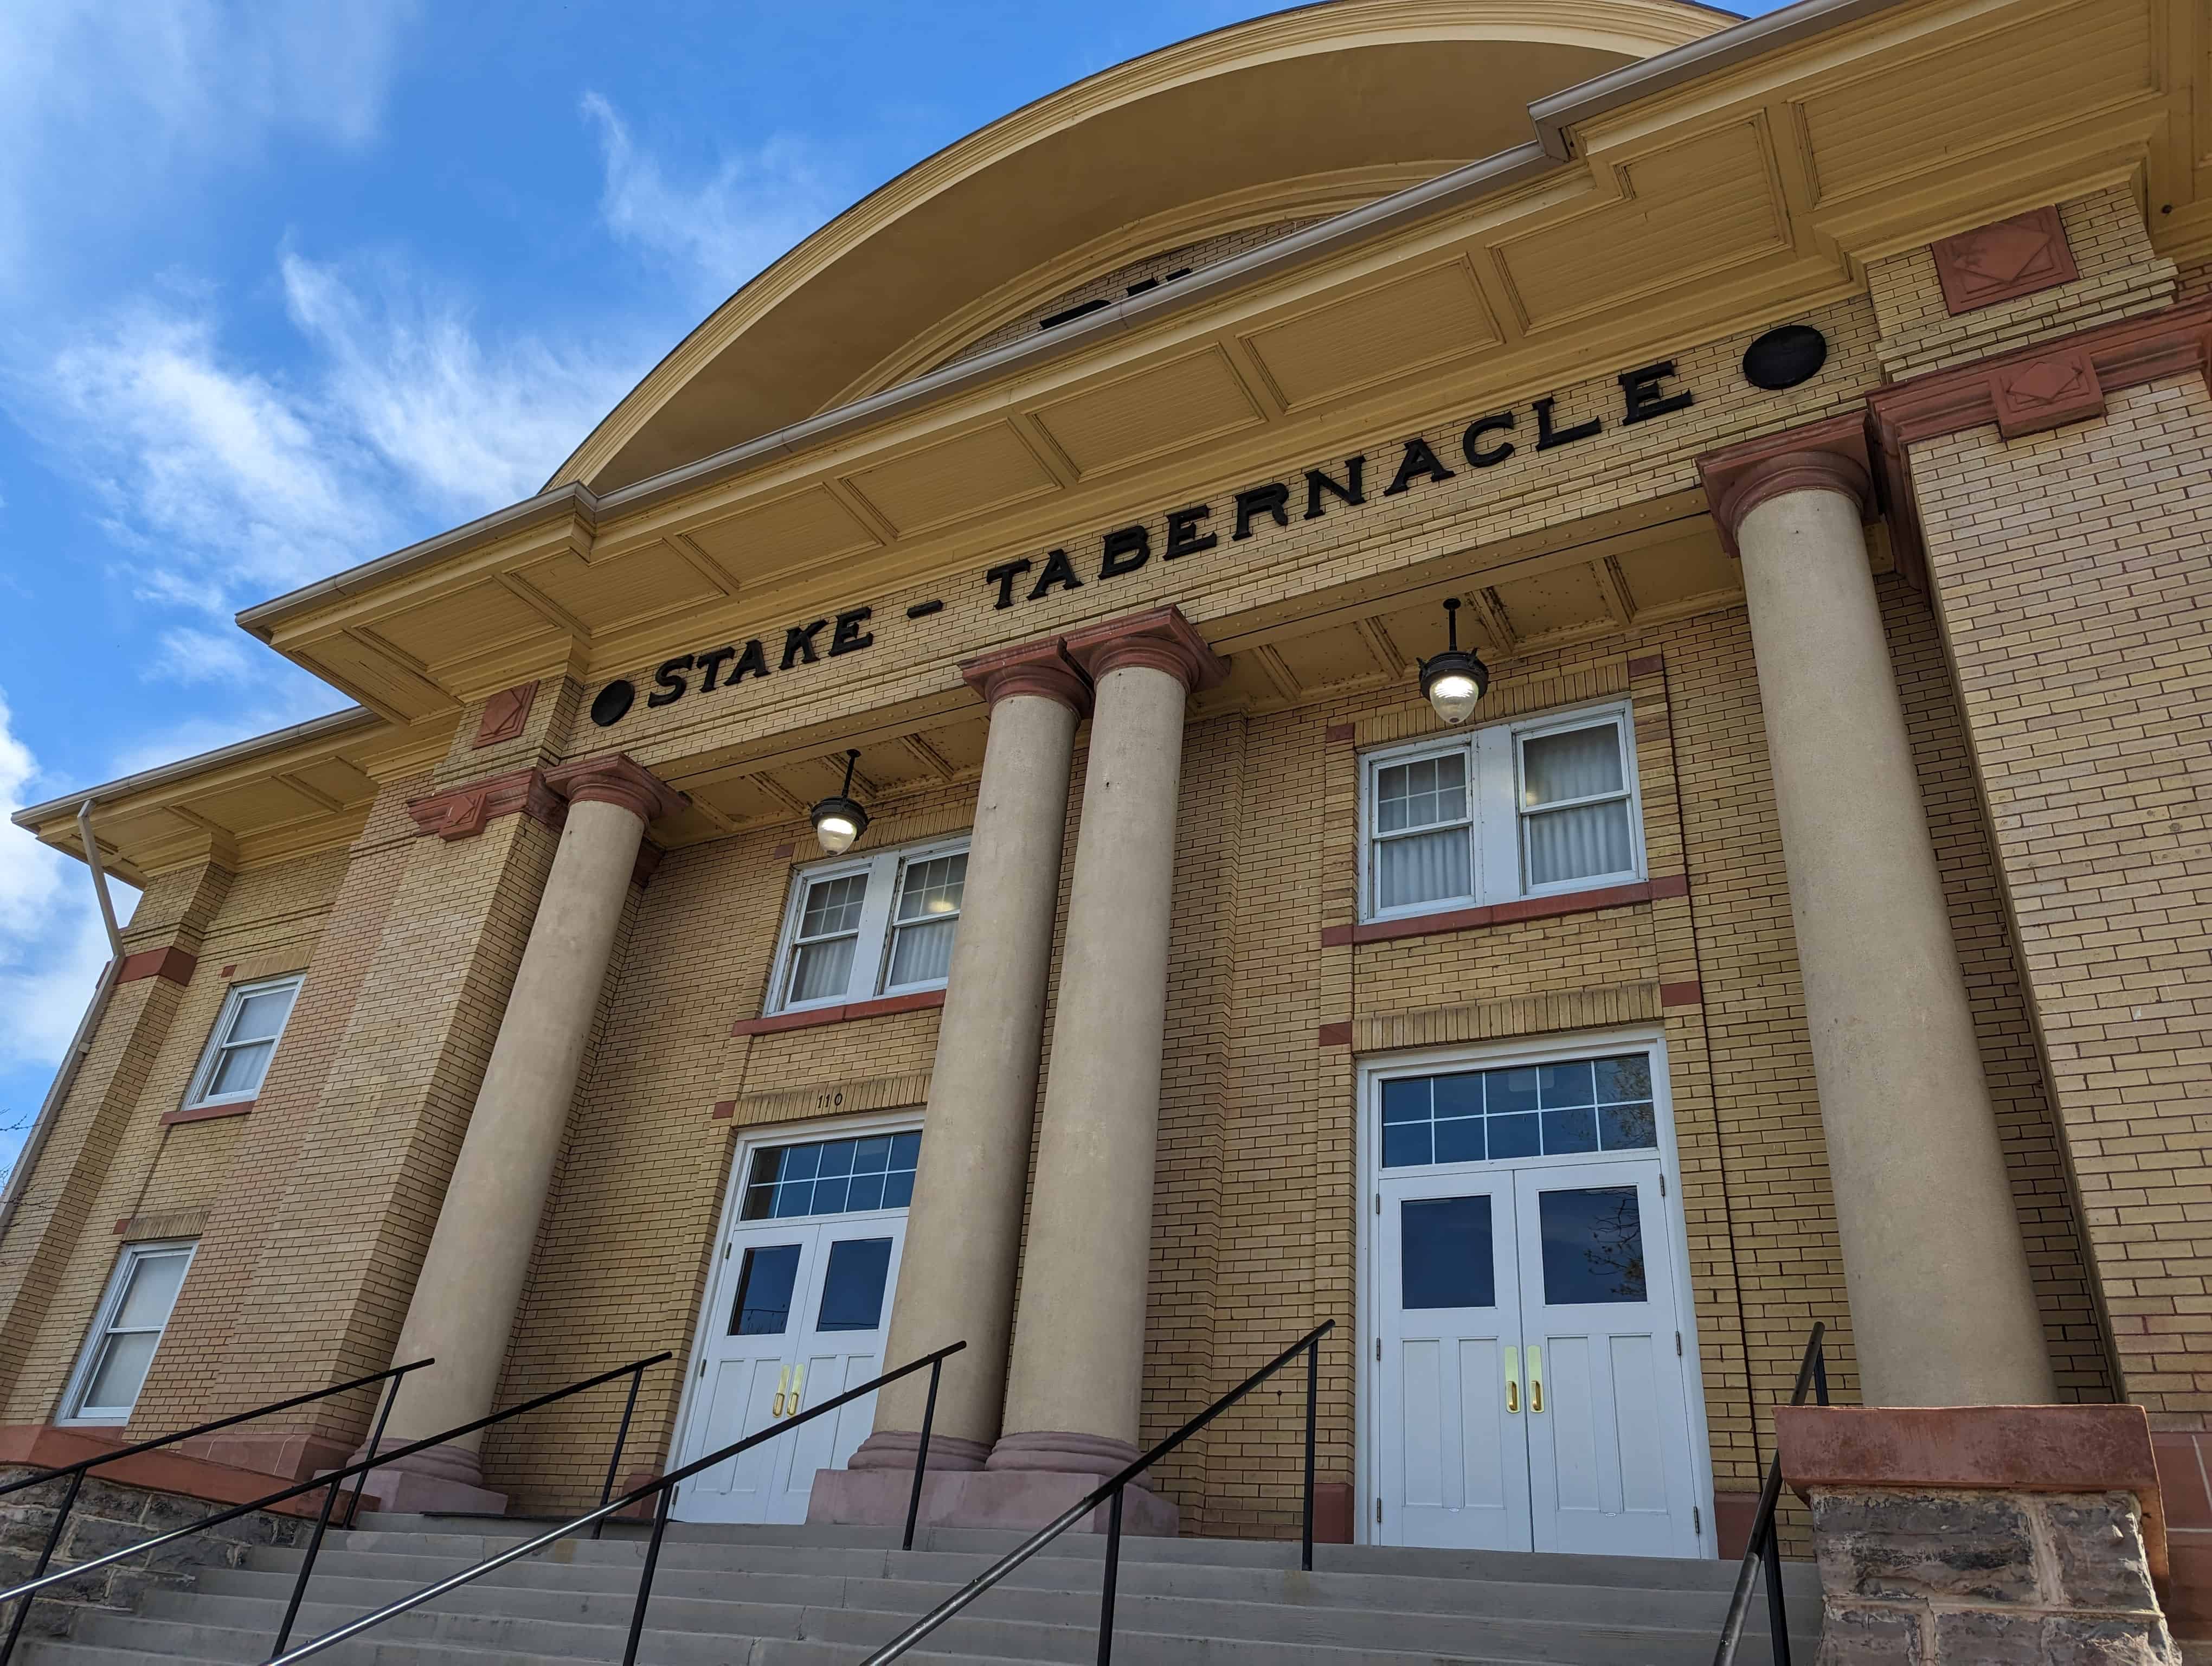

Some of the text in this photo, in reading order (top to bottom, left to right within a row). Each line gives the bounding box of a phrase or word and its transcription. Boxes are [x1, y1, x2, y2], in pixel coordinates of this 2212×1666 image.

[648, 607, 873, 709] STAKE
[986, 360, 1694, 610] TABERNACLE
[818, 1093, 843, 1108] 110
